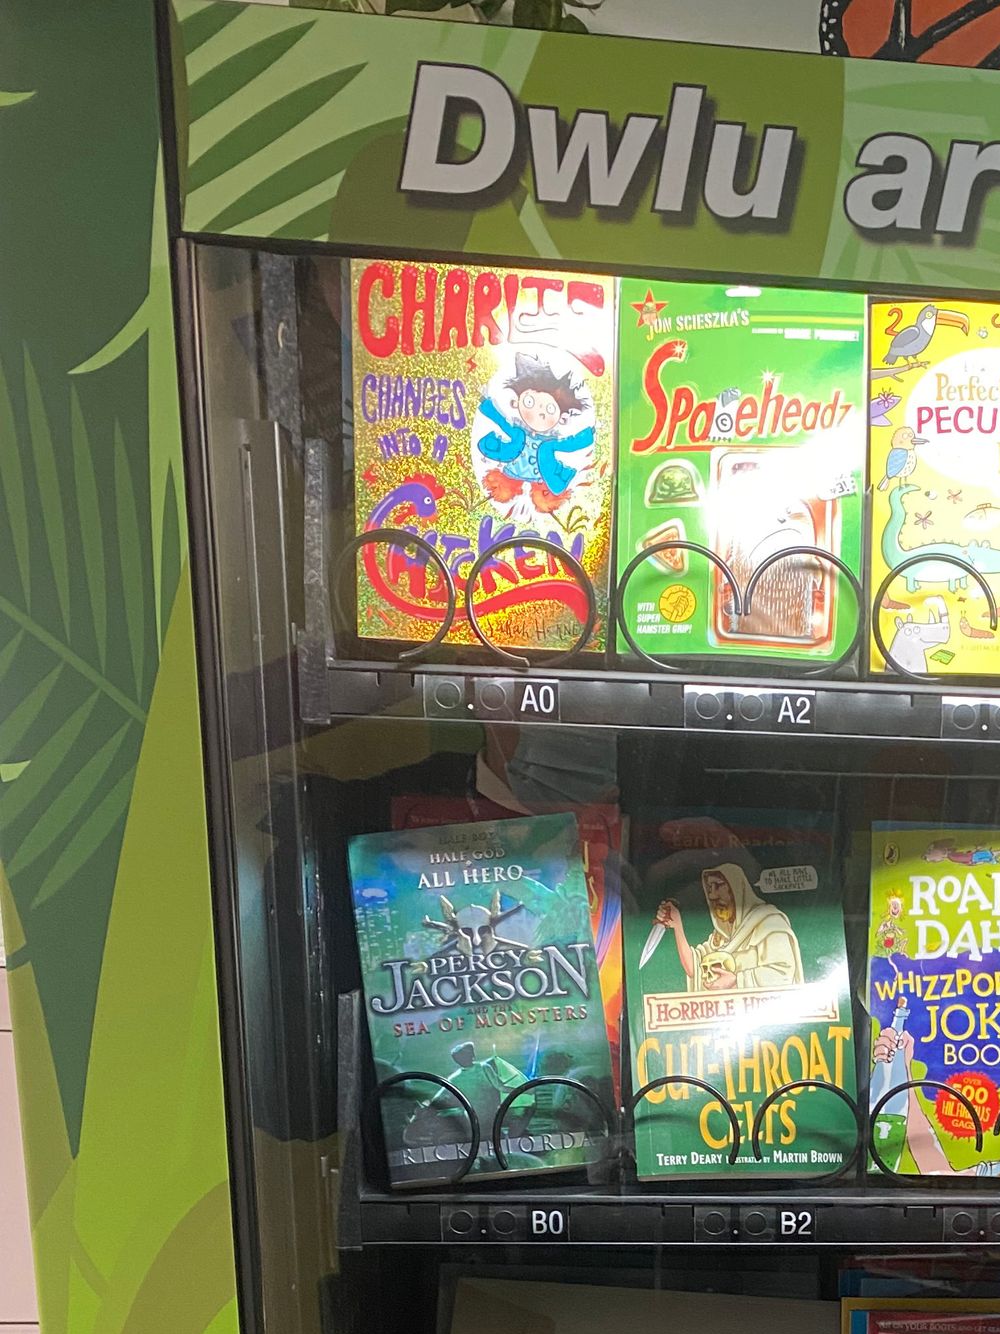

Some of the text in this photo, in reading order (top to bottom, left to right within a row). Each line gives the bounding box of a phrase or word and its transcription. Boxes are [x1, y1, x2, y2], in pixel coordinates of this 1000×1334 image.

[399, 60, 797, 222] Dwlu
[676, 308, 750, 332] SCIESZKA'S
[361, 373, 466, 429] CHANGES
[378, 429, 448, 463] INTO A
[637, 602, 655, 611] WITH
[637, 613, 660, 623] SUPER
[637, 624, 670, 634] HAMSTER
[520, 685, 555, 713] A0
[777, 697, 811, 724] A2
[430, 847, 505, 865] HALF GOD
[417, 864, 524, 890] ALL HERO
[427, 948, 527, 975] PERCY
[371, 943, 592, 1015] JACKSON
[393, 1005, 588, 1037] SEA OF MONSTERS
[656, 999, 735, 1022] HORRIBLE
[637, 1026, 851, 1104] CUT-THROAT
[402, 1142, 470, 1165] RICK
[656, 1150, 843, 1166] TERRY DEARY MARTIN BROWN
[532, 1211, 563, 1234] B0
[780, 1211, 811, 1235] B2
